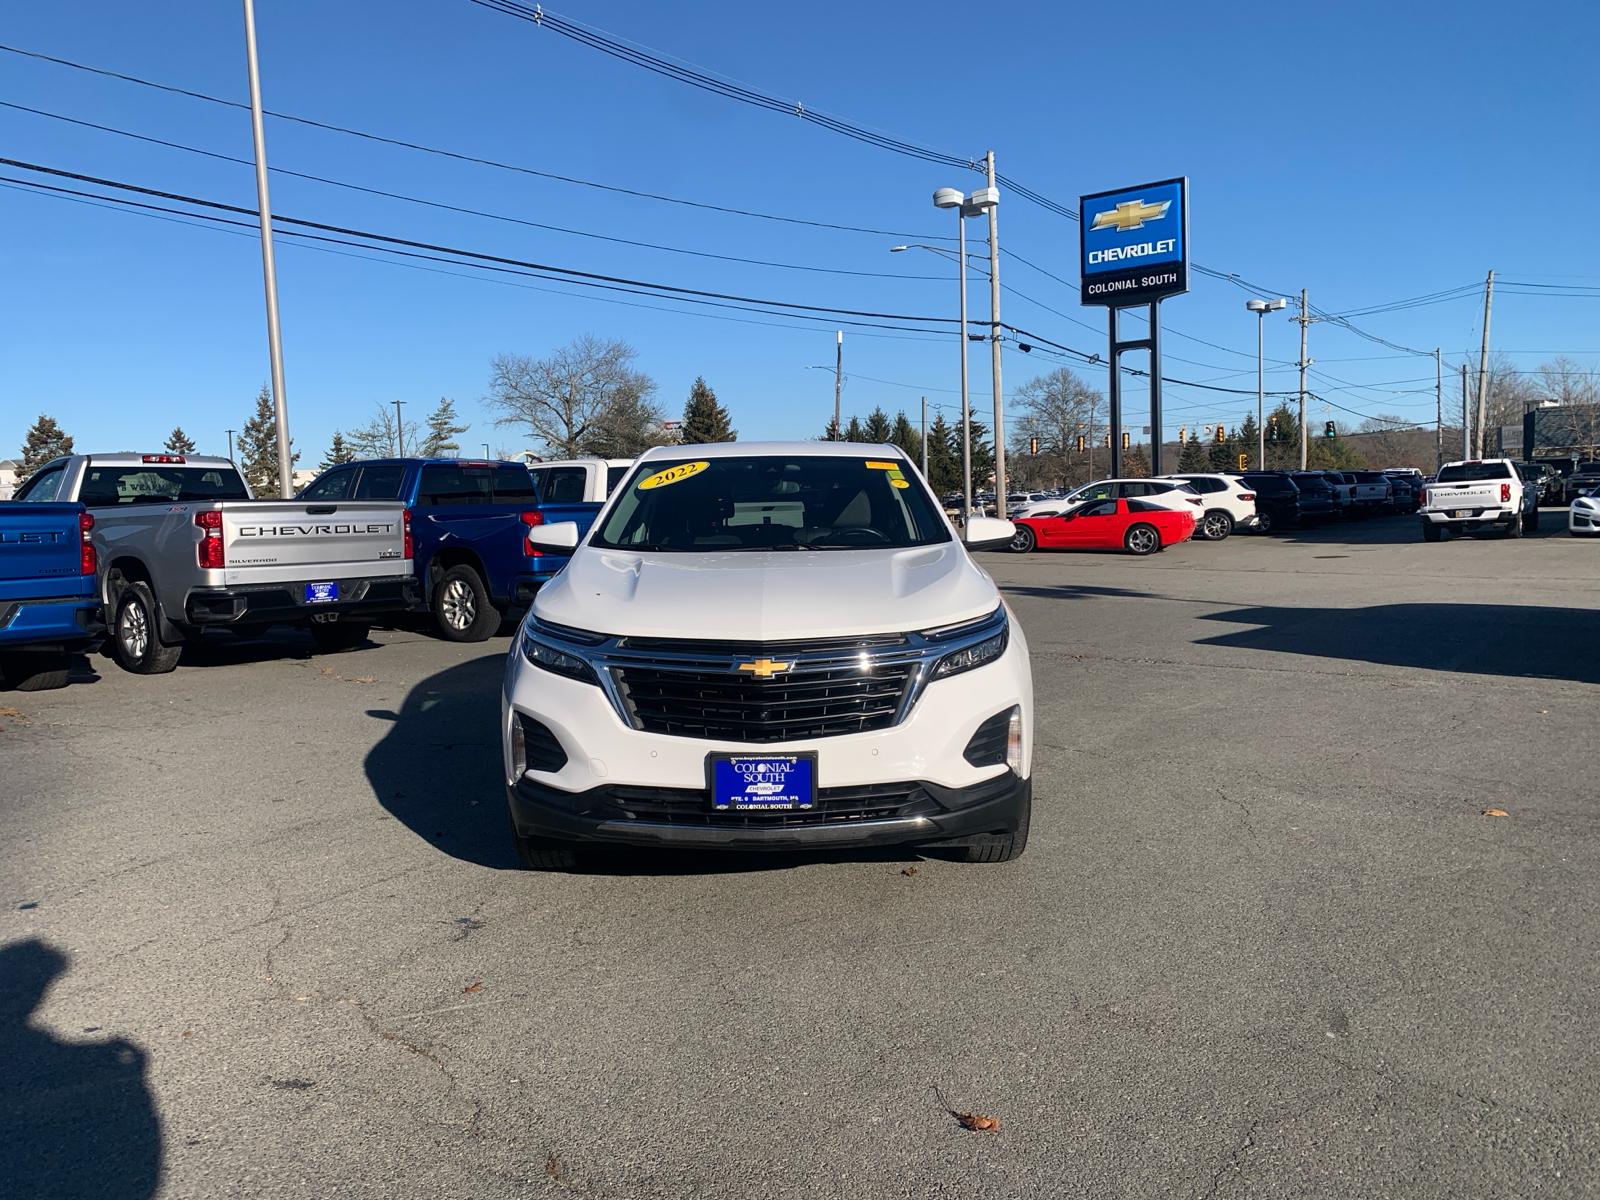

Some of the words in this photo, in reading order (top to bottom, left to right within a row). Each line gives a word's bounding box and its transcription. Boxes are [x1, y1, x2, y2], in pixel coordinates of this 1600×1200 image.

[1088, 238, 1176, 265] CHEVROLET
[1088, 278, 1138, 295] COLONIAL
[1141, 272, 1177, 287] SOUTH
[653, 463, 698, 486] 2022
[239, 524, 395, 537] CHEVROLET
[734, 763, 794, 773] COLONIAL
[743, 773, 785, 783] SOUTH
